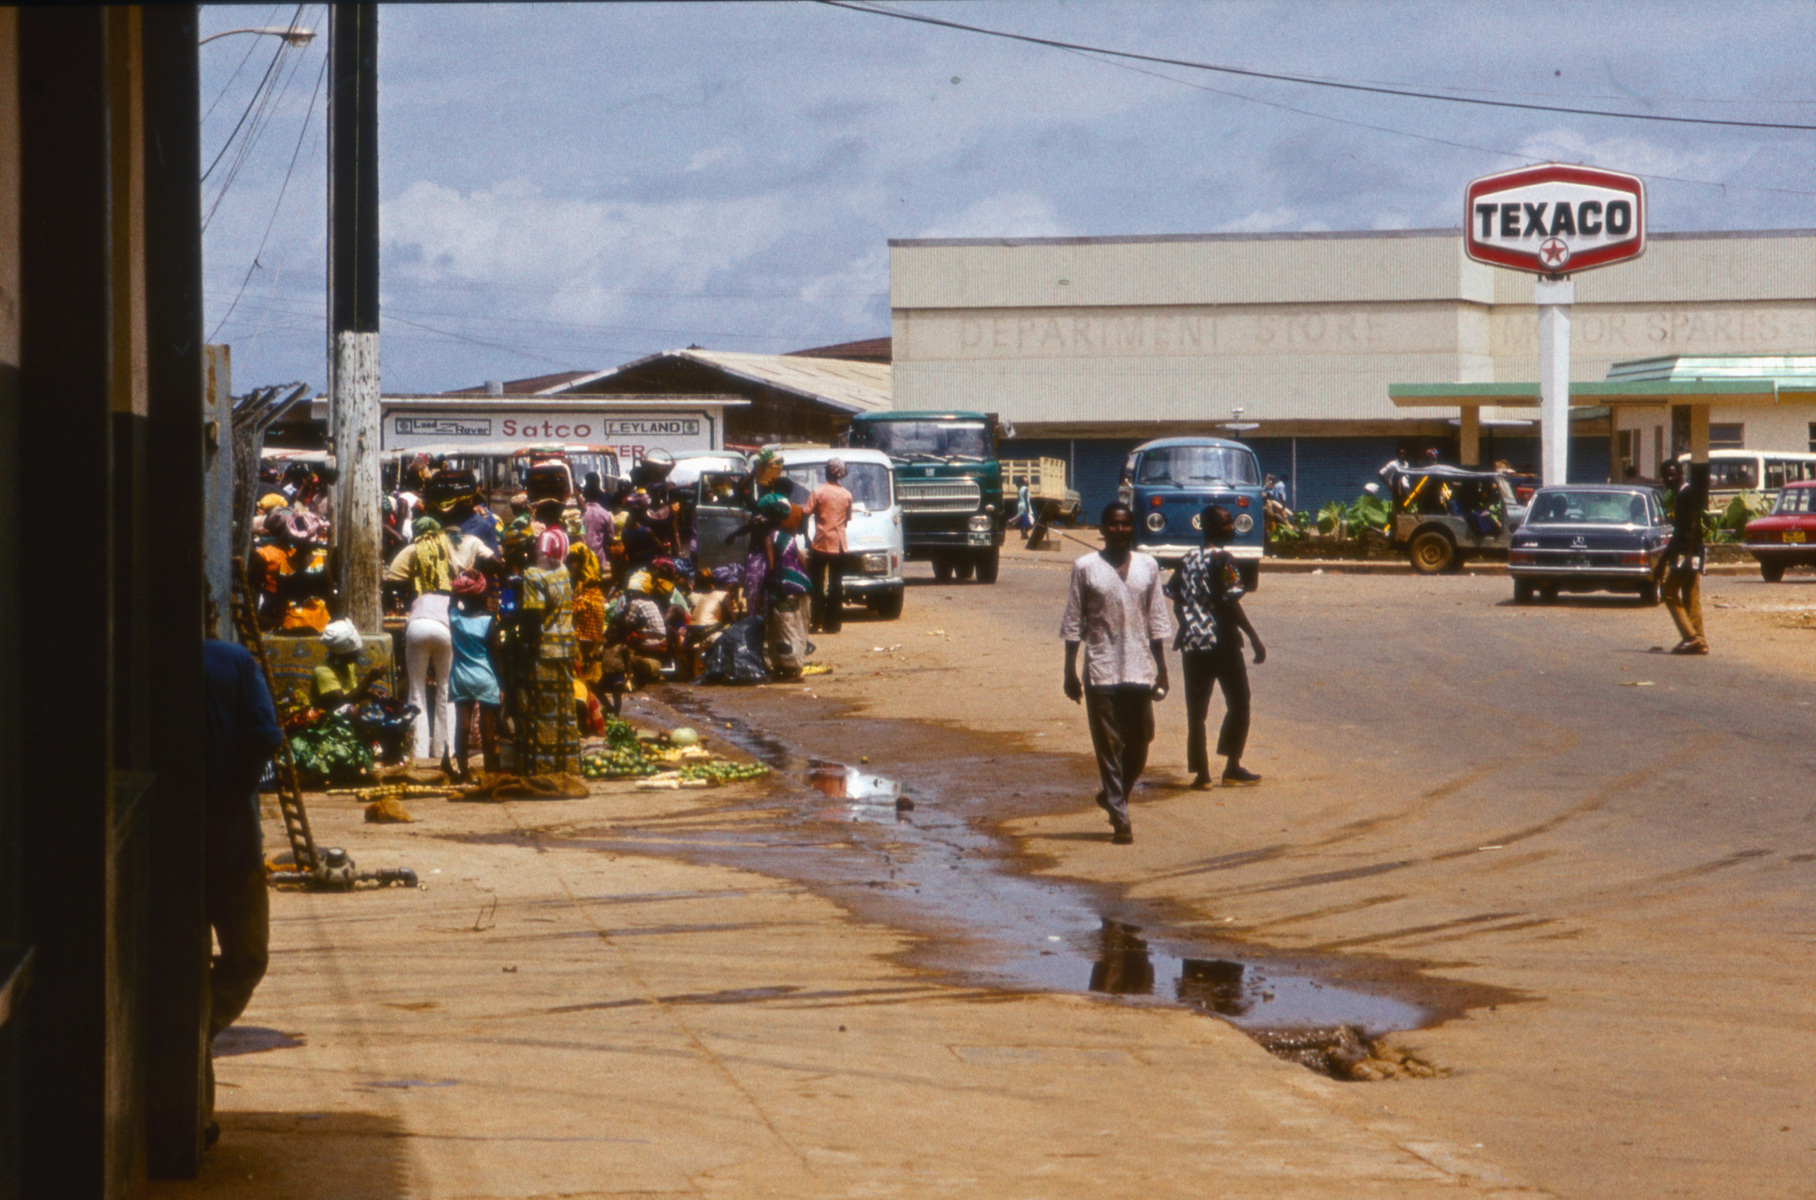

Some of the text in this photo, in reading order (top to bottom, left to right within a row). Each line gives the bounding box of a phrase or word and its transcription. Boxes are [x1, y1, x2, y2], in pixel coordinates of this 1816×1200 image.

[1475, 200, 1632, 237] TEXACO
[961, 311, 1387, 349] DEPARTMENT STORE
[414, 419, 488, 435] Land Rover
[502, 419, 592, 438] Satco
[608, 422, 681, 433] LEYLAND
